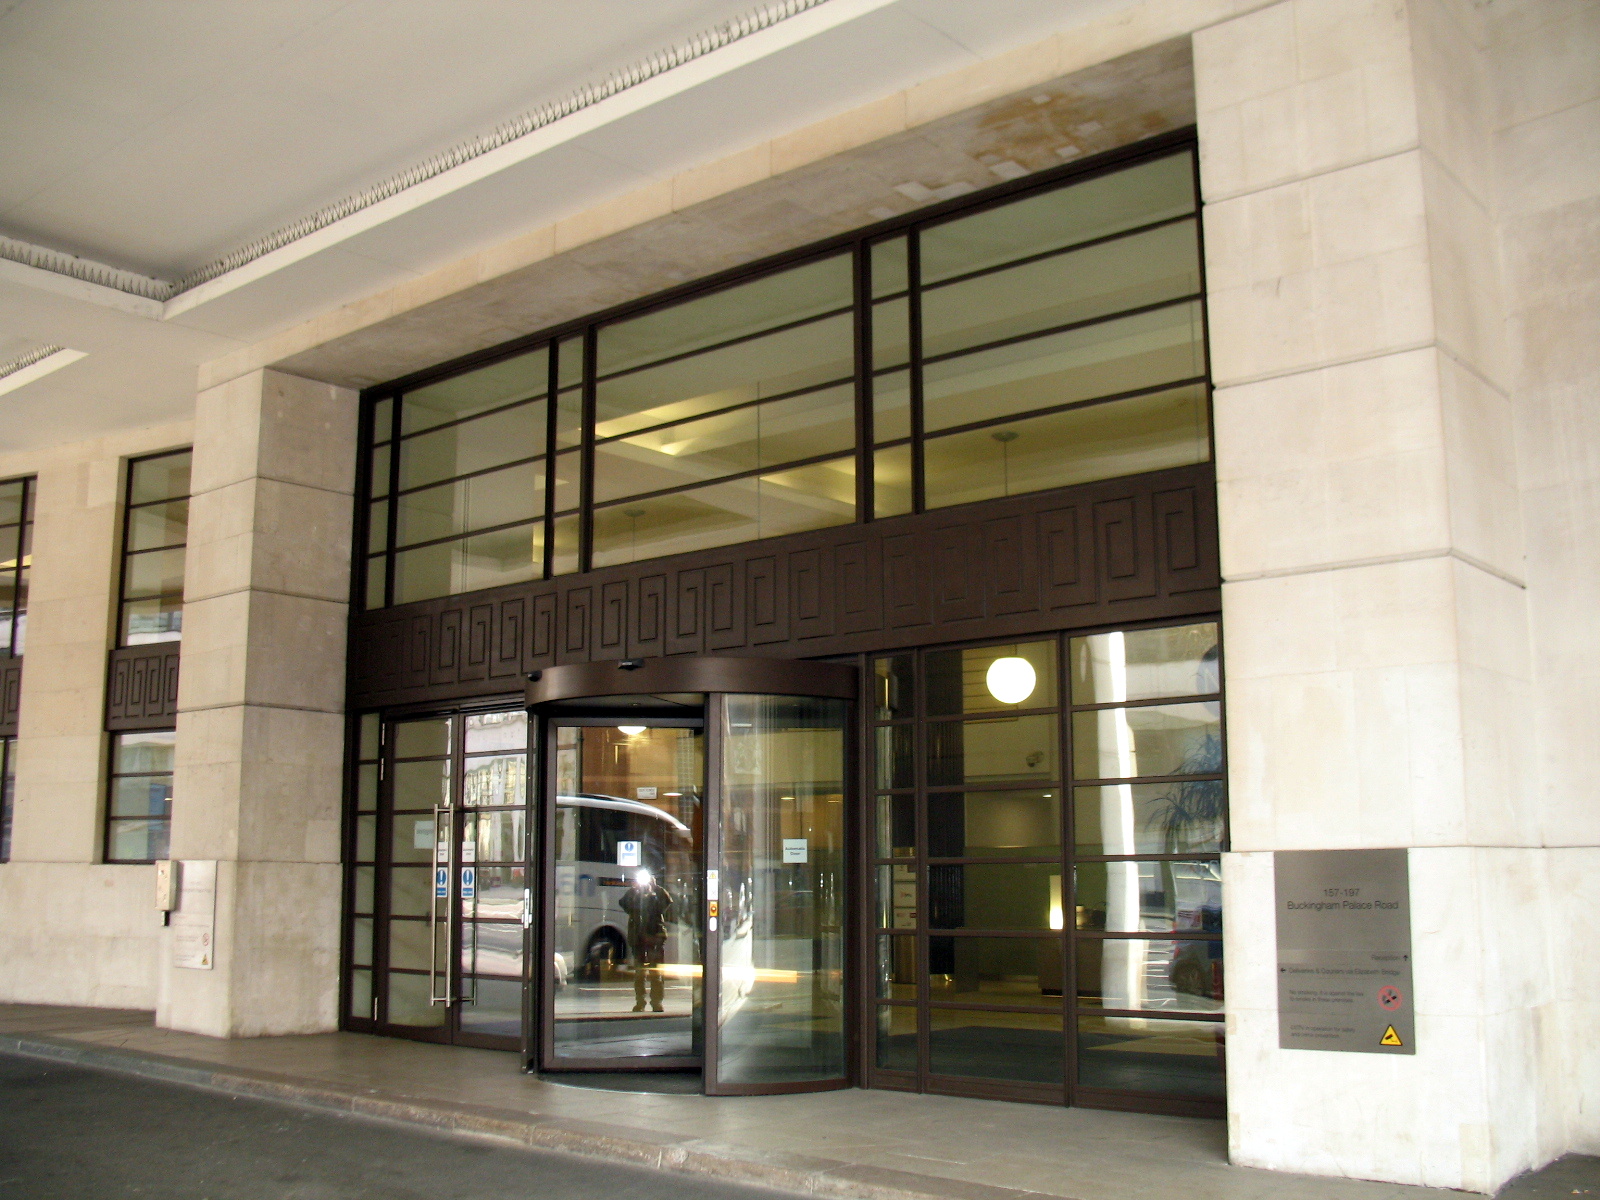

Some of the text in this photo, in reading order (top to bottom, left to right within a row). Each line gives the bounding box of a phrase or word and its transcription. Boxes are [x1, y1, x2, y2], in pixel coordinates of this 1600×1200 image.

[1323, 888, 1360, 897] 157-197
[1287, 900, 1399, 912] Buckingham Palace Road
